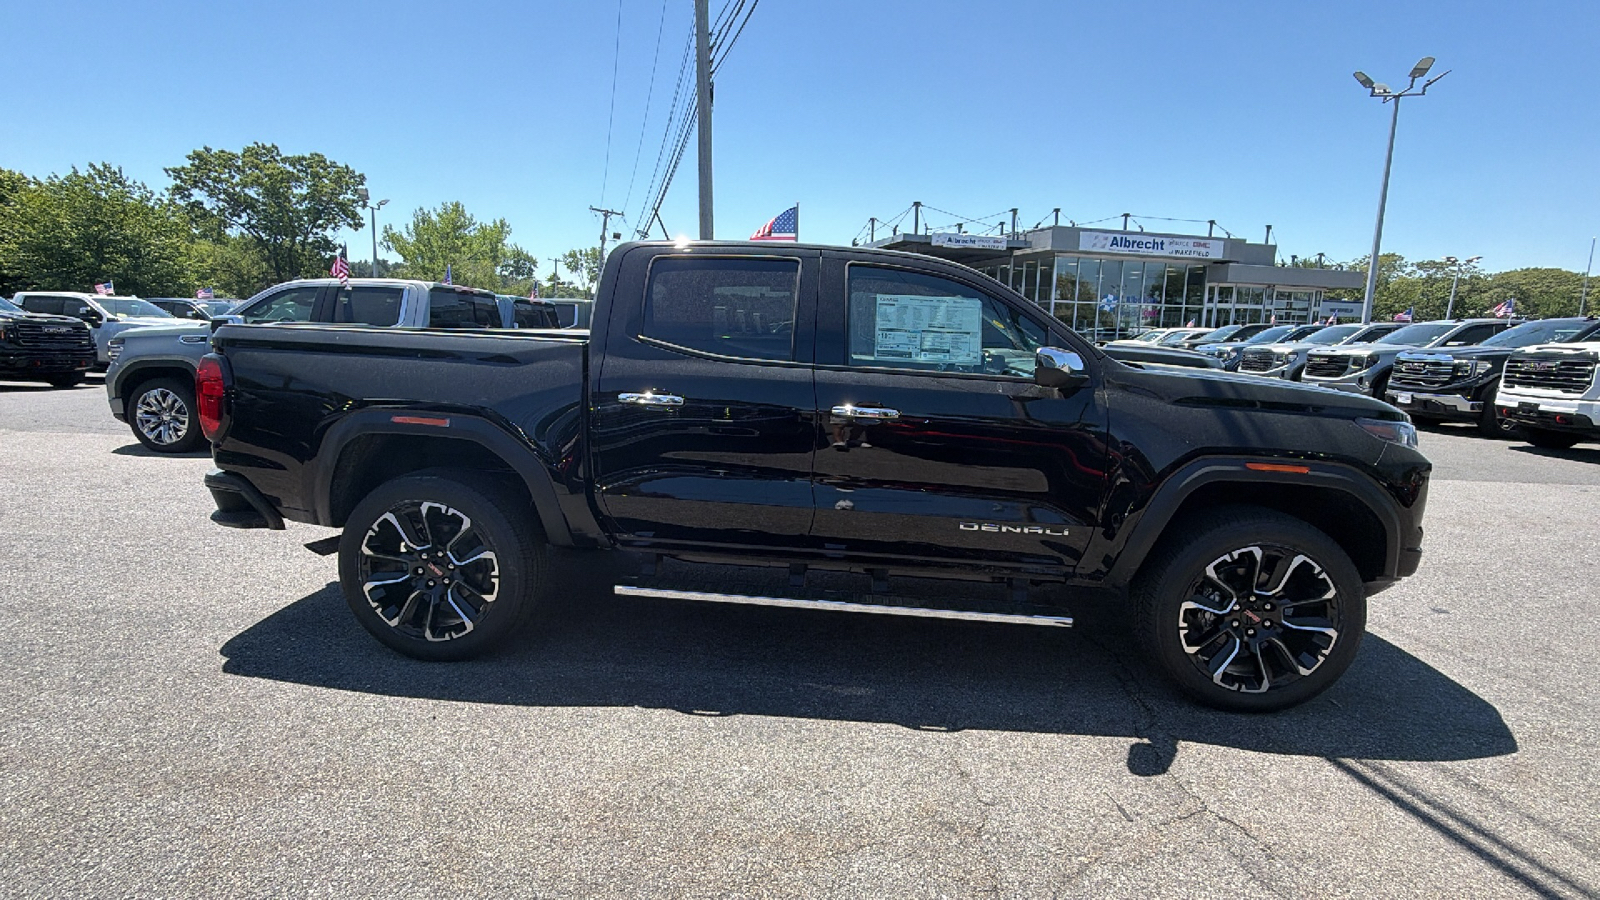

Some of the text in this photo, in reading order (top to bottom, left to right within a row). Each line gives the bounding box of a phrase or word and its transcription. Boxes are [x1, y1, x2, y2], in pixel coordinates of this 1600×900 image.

[1109, 236, 1165, 250] Albrecht
[1193, 241, 1211, 249] GMC
[1174, 249, 1210, 257] WAKEFIELD
[960, 522, 1069, 536] DENALI
